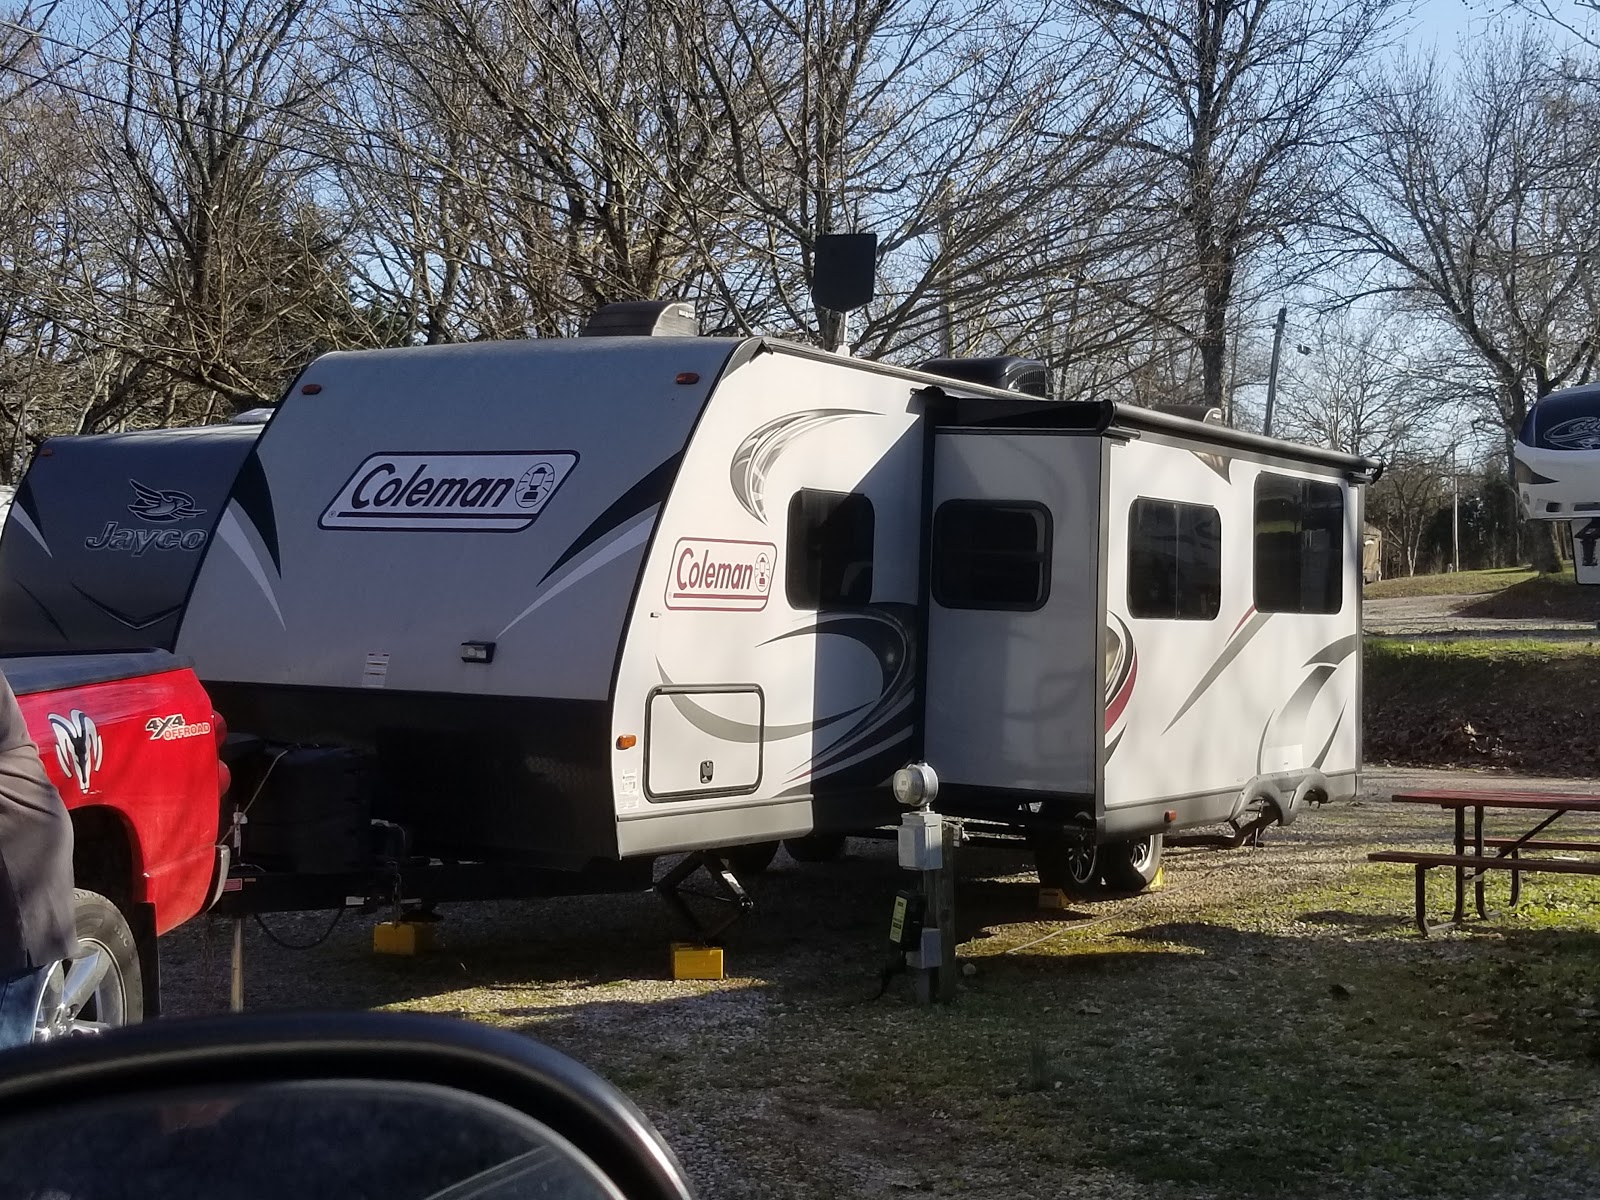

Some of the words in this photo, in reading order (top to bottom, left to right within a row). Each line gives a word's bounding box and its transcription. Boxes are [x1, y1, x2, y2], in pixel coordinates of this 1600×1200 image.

[351, 463, 515, 510] Coleman
[84, 521, 208, 557] Jayco
[676, 547, 754, 591] Coleman
[163, 722, 211, 740] OFFROAD
